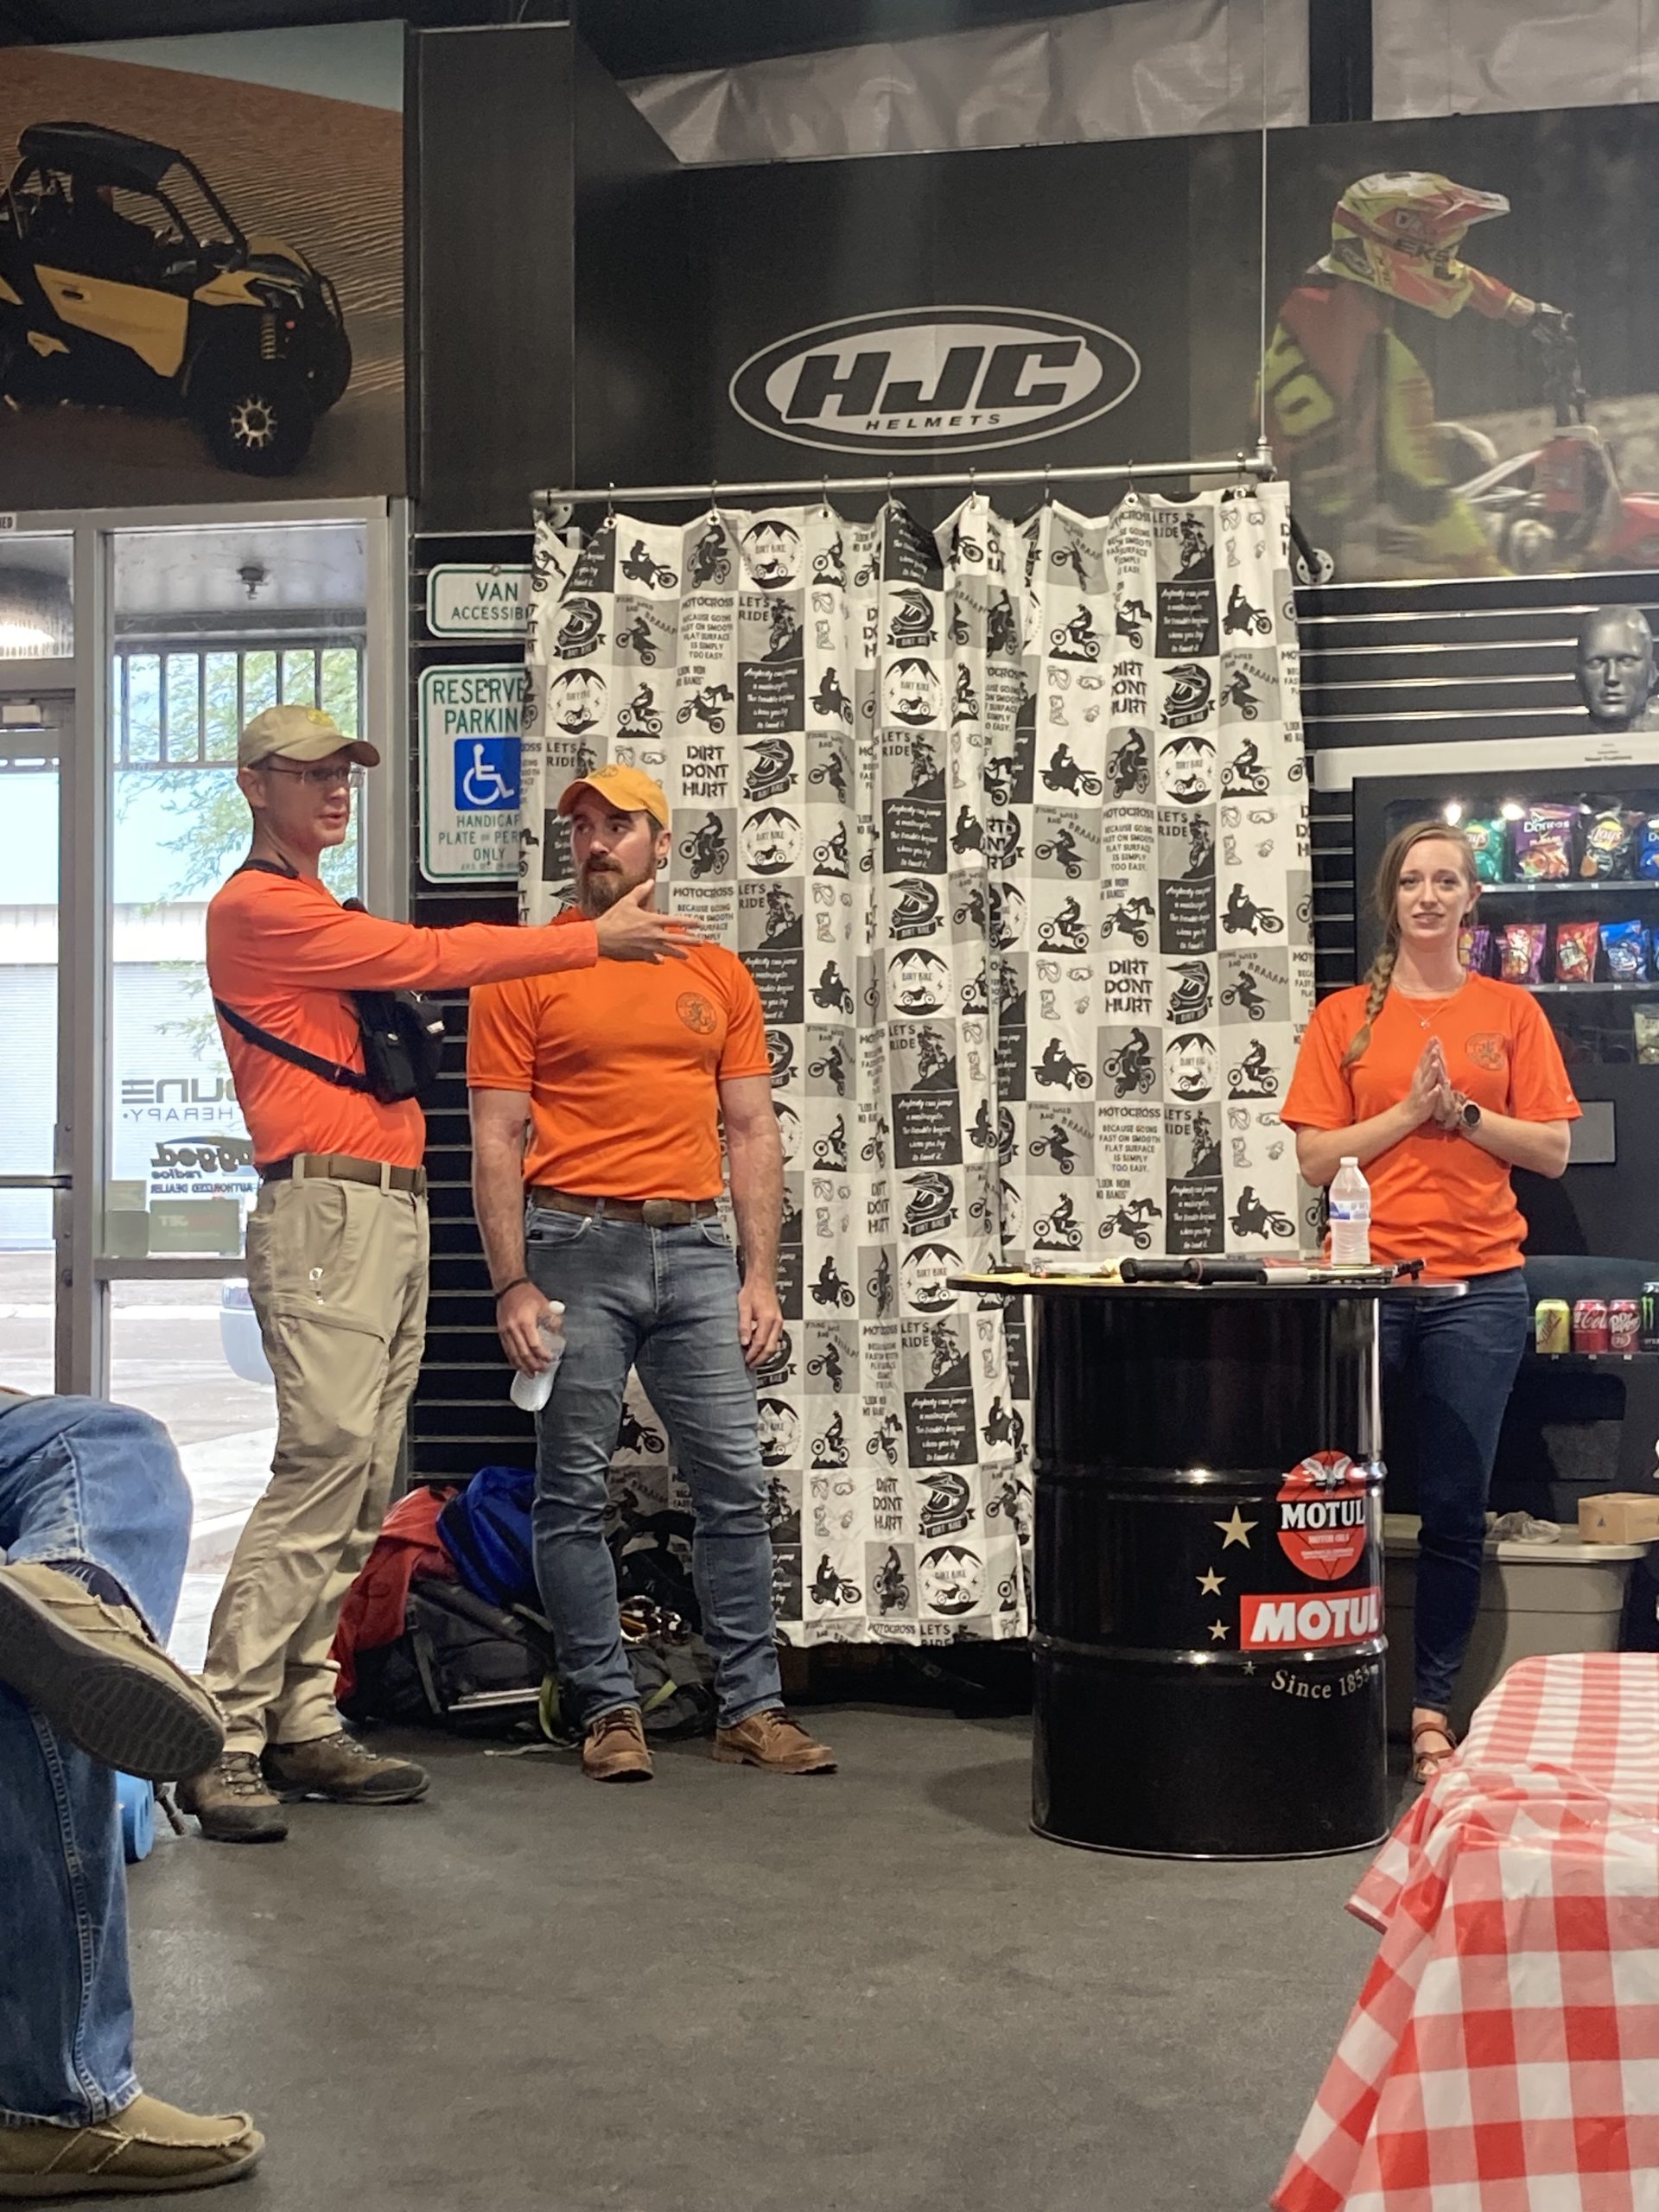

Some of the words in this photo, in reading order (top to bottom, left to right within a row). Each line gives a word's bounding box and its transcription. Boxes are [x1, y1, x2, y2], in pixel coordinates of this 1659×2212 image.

[785, 340, 1082, 419] HJC
[865, 413, 1001, 431] HELMETS
[476, 582, 518, 601] VAN
[451, 606, 524, 620] ACCESSIB
[739, 610, 769, 621] RIDE
[433, 678, 524, 705] RESERVE
[1111, 680, 1147, 696] ONT
[444, 708, 518, 734] PARKIN
[687, 745, 725, 760] DIRT
[881, 746, 910, 756] RIDE
[546, 757, 576, 767] RIDE
[682, 764, 729, 778] DONT
[683, 782, 728, 798] HURT
[1158, 826, 1187, 837] RIDE
[1523, 821, 1570, 834] Doritos
[438, 831, 476, 845] PLATE
[494, 830, 519, 844] PER
[474, 848, 505, 861] ONLY
[673, 887, 734, 898] MOTOCROSS
[739, 898, 765, 908] RIDE
[1109, 958, 1148, 976] DIRT
[1105, 978, 1153, 995] DONT
[1105, 997, 1153, 1016] HURT
[889, 1039, 916, 1051] RIDE
[1098, 1108, 1160, 1118] MOTOCROSS
[1135, 1125, 1157, 1134] GOING
[1125, 1145, 1155, 1154] SURFACE
[901, 1336, 930, 1348] RIDE
[876, 1478, 898, 1493] DIRT
[873, 1496, 903, 1511] DONT
[1281, 1500, 1365, 1529] MOTUL
[874, 1515, 903, 1531] HURT
[1250, 1594, 1379, 1643] MOTUL
[1271, 1669, 1332, 1699] Since
